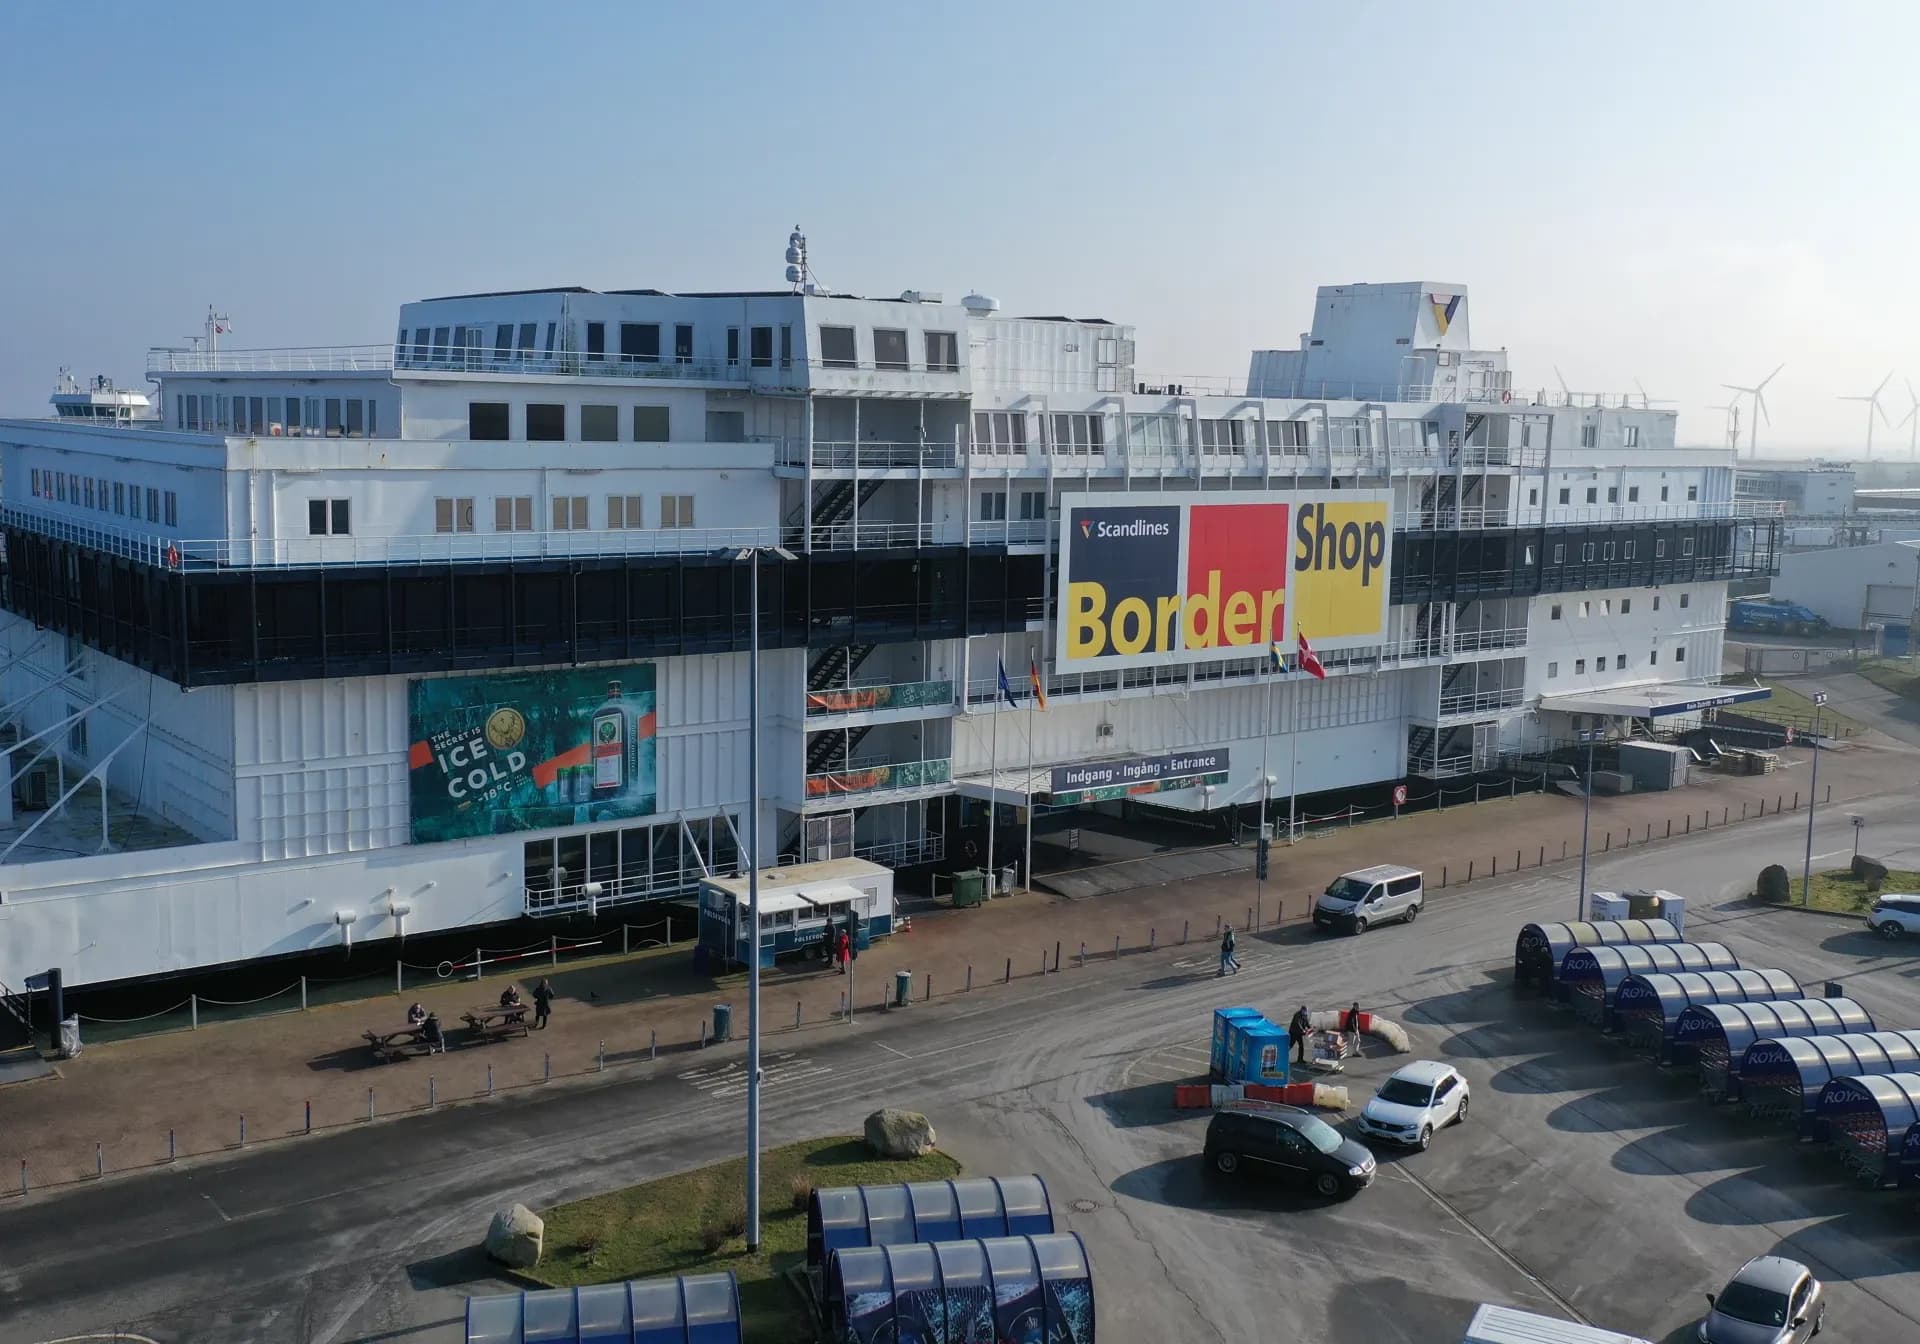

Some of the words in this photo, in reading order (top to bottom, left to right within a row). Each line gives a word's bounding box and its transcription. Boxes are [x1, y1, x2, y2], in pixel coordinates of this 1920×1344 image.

[1097, 519, 1169, 538] Scandlines
[1295, 503, 1386, 587] Shop
[1067, 570, 1285, 660] Border
[431, 731, 451, 743] THE
[434, 731, 469, 751] SECRET
[471, 726, 481, 735] IS
[438, 737, 488, 774] ICE
[1066, 769, 1113, 786] Indgang
[1123, 761, 1161, 778] Ingång
[1171, 755, 1216, 771] Entrance
[448, 751, 526, 798] COLD
[1567, 959, 1600, 970] ROYA
